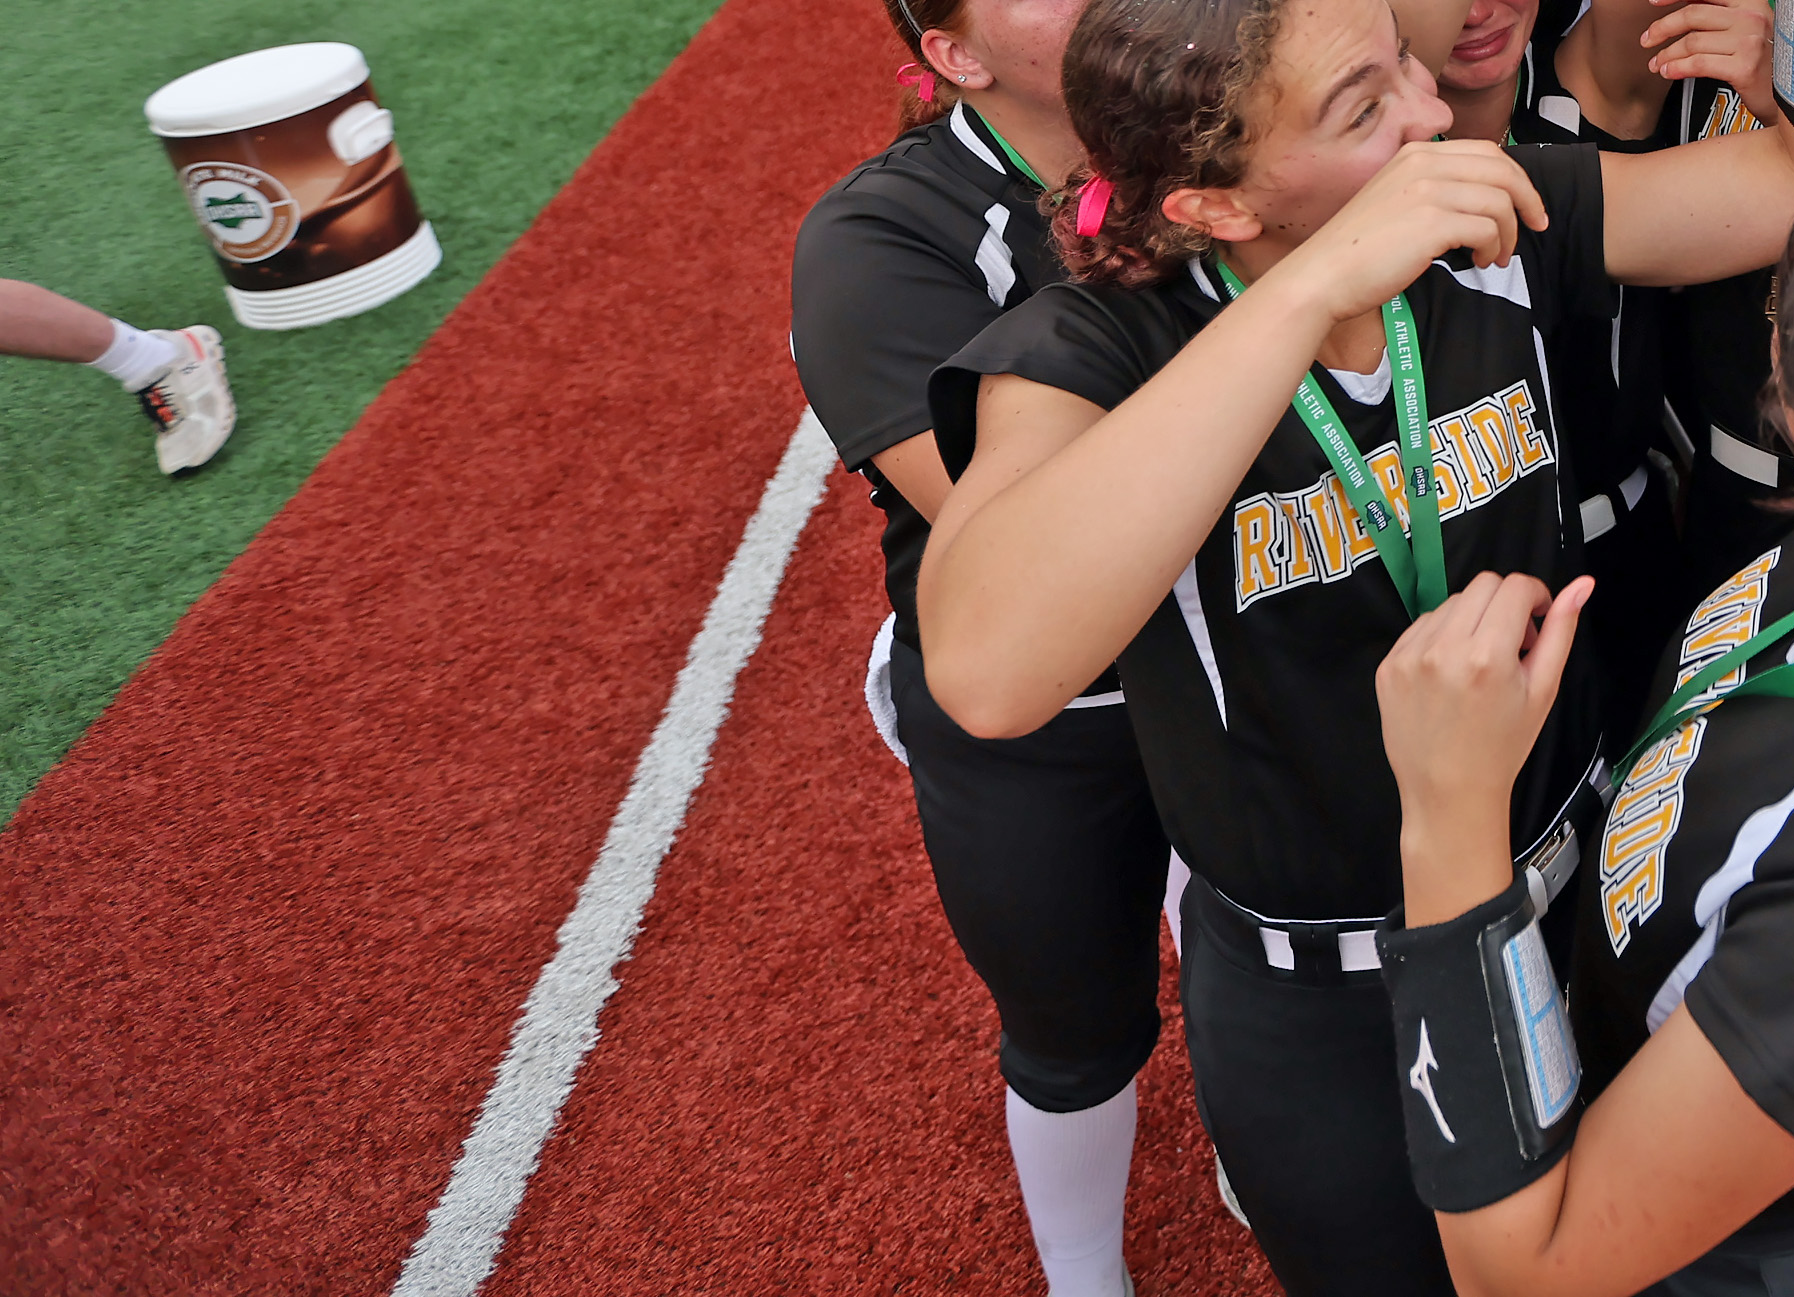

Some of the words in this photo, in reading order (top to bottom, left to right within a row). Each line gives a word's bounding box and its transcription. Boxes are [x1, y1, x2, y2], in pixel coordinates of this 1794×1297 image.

[1394, 321, 1413, 371] ATHLETIC
[1403, 378, 1422, 449] ASSOCIATION
[1321, 423, 1366, 489] ASSOCIATION
[1367, 502, 1387, 532] OHSAA
[1415, 467, 1426, 497] OHSAA
